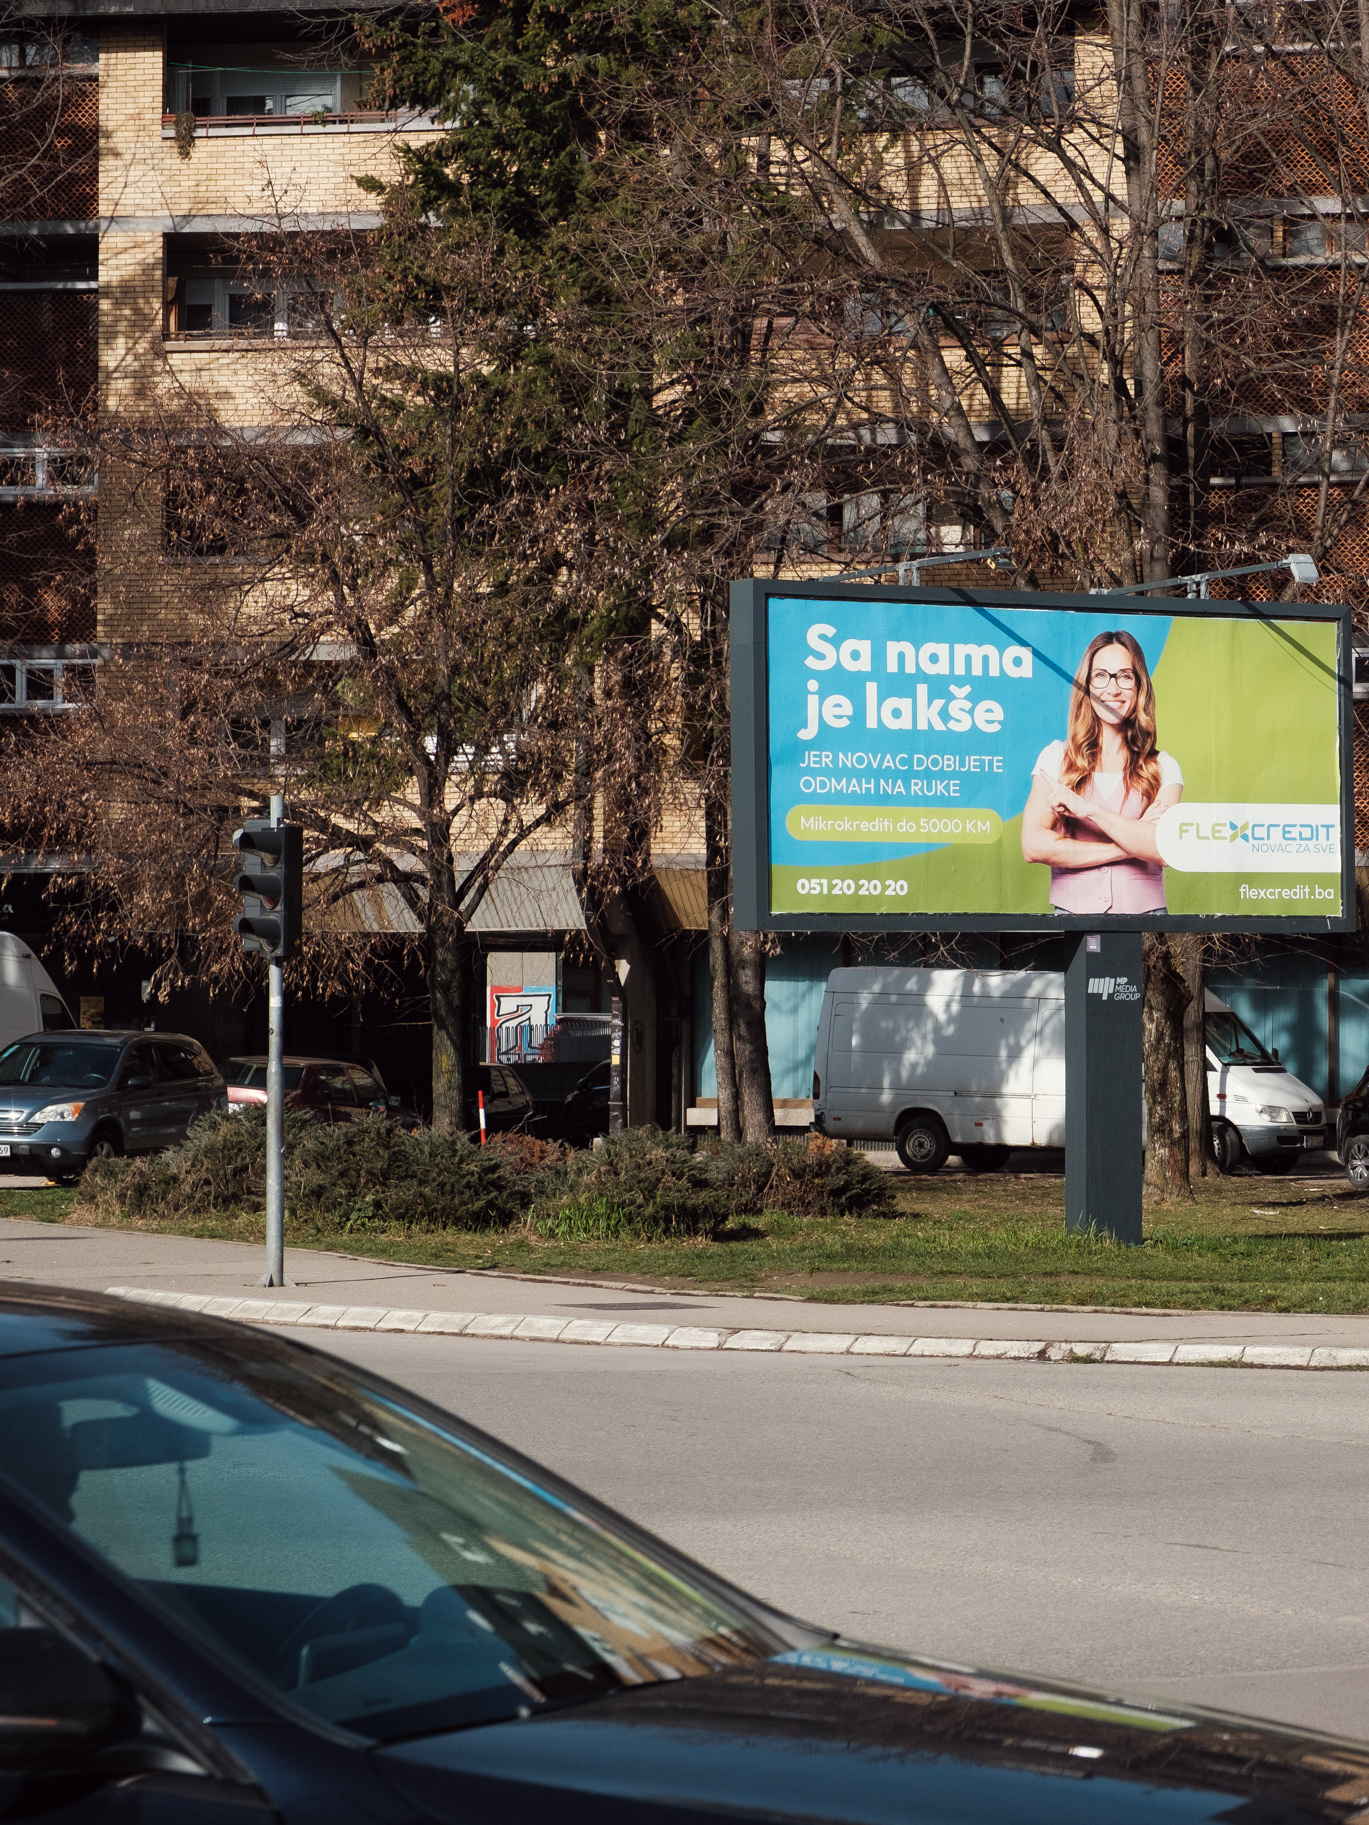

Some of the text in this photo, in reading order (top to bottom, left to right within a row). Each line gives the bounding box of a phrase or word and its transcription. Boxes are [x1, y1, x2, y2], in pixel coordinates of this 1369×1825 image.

[804, 623, 1033, 678] Sa nama
[796, 679, 1004, 740] je lakše
[799, 751, 1004, 773] JER NOVAC DOBIJETE
[800, 776, 961, 797] ODMAH NA RUKE
[800, 815, 990, 834] Mikrokrediti do 5000 KM
[1178, 820, 1336, 843] FLEXCREDIT
[1251, 843, 1336, 854] NOVAC ZA SVE
[796, 878, 909, 896] 051 20 20 20
[1239, 884, 1335, 900] flexcredit.ba
[1114, 985, 1137, 993] MEDIA
[1116, 977, 1128, 985] MP
[1113, 993, 1141, 1001] GROUP
